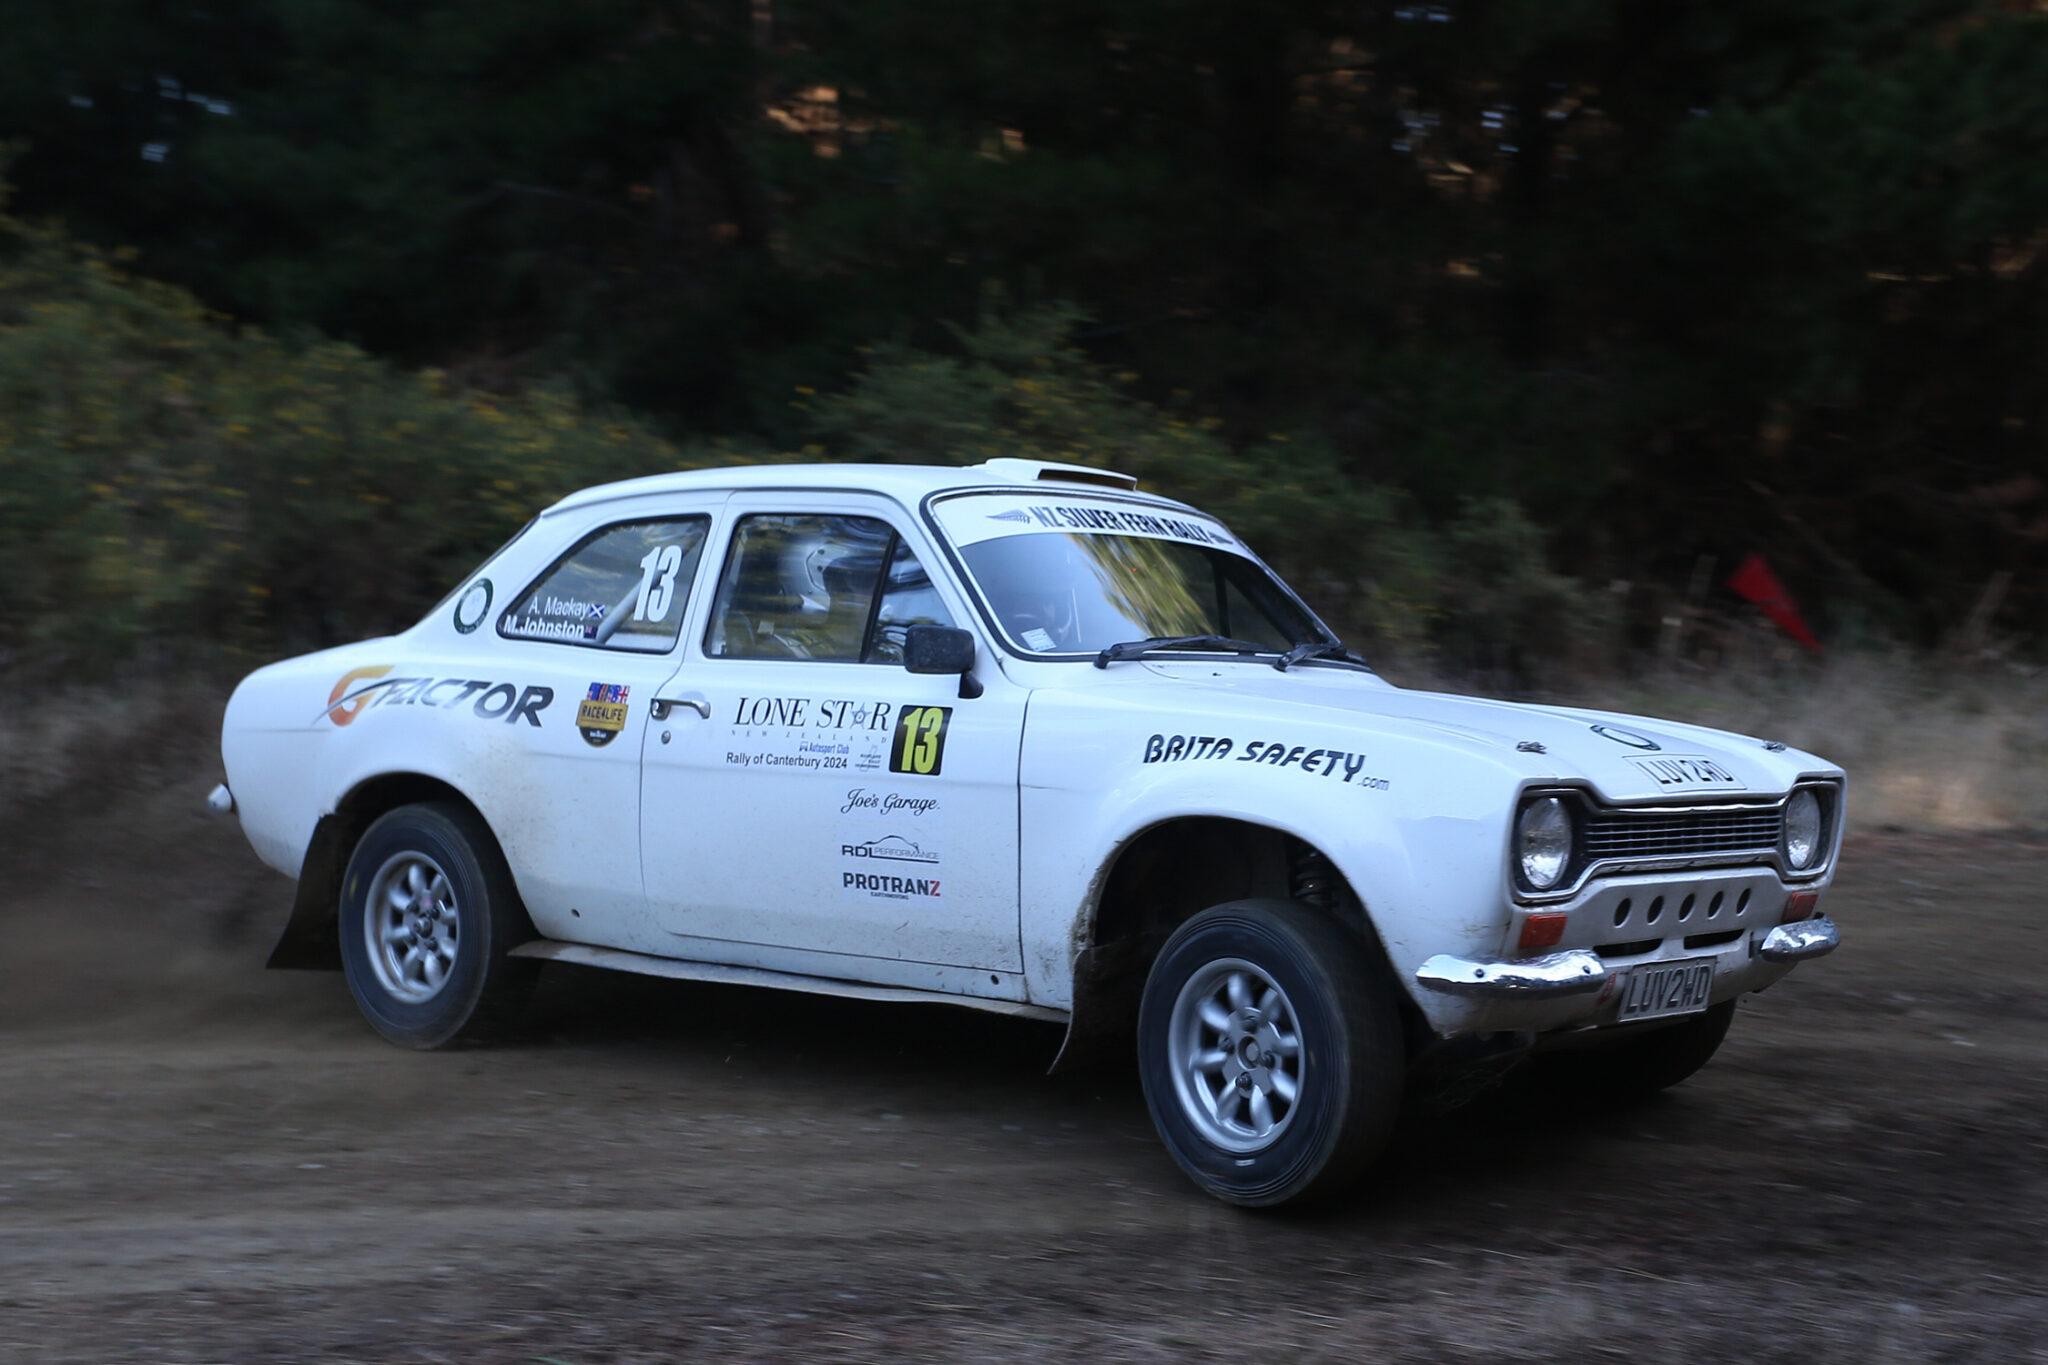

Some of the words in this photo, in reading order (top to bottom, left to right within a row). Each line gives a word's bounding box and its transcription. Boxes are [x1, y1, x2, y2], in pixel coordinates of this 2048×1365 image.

[1029, 506, 1063, 527] NZ
[1058, 507, 1126, 531] SILVER
[1122, 513, 1165, 535] FERN
[1162, 520, 1214, 544] RALLY
[633, 545, 682, 622] 13
[528, 597, 540, 614] A.
[544, 597, 590, 621] Mackay
[582, 705, 624, 721] RACE4LIFE
[733, 697, 810, 728] LONE
[901, 707, 944, 773] 13
[1143, 733, 1234, 763] BRITA
[726, 752, 750, 766] Rally
[752, 753, 763, 764] of
[766, 754, 822, 770] Canterbury
[823, 756, 848, 768] 2024
[840, 788, 879, 814] Joe's
[842, 845, 873, 858] RDL
[873, 847, 939, 860] PERFORMANCE
[843, 872, 941, 896] PROTRANZ
